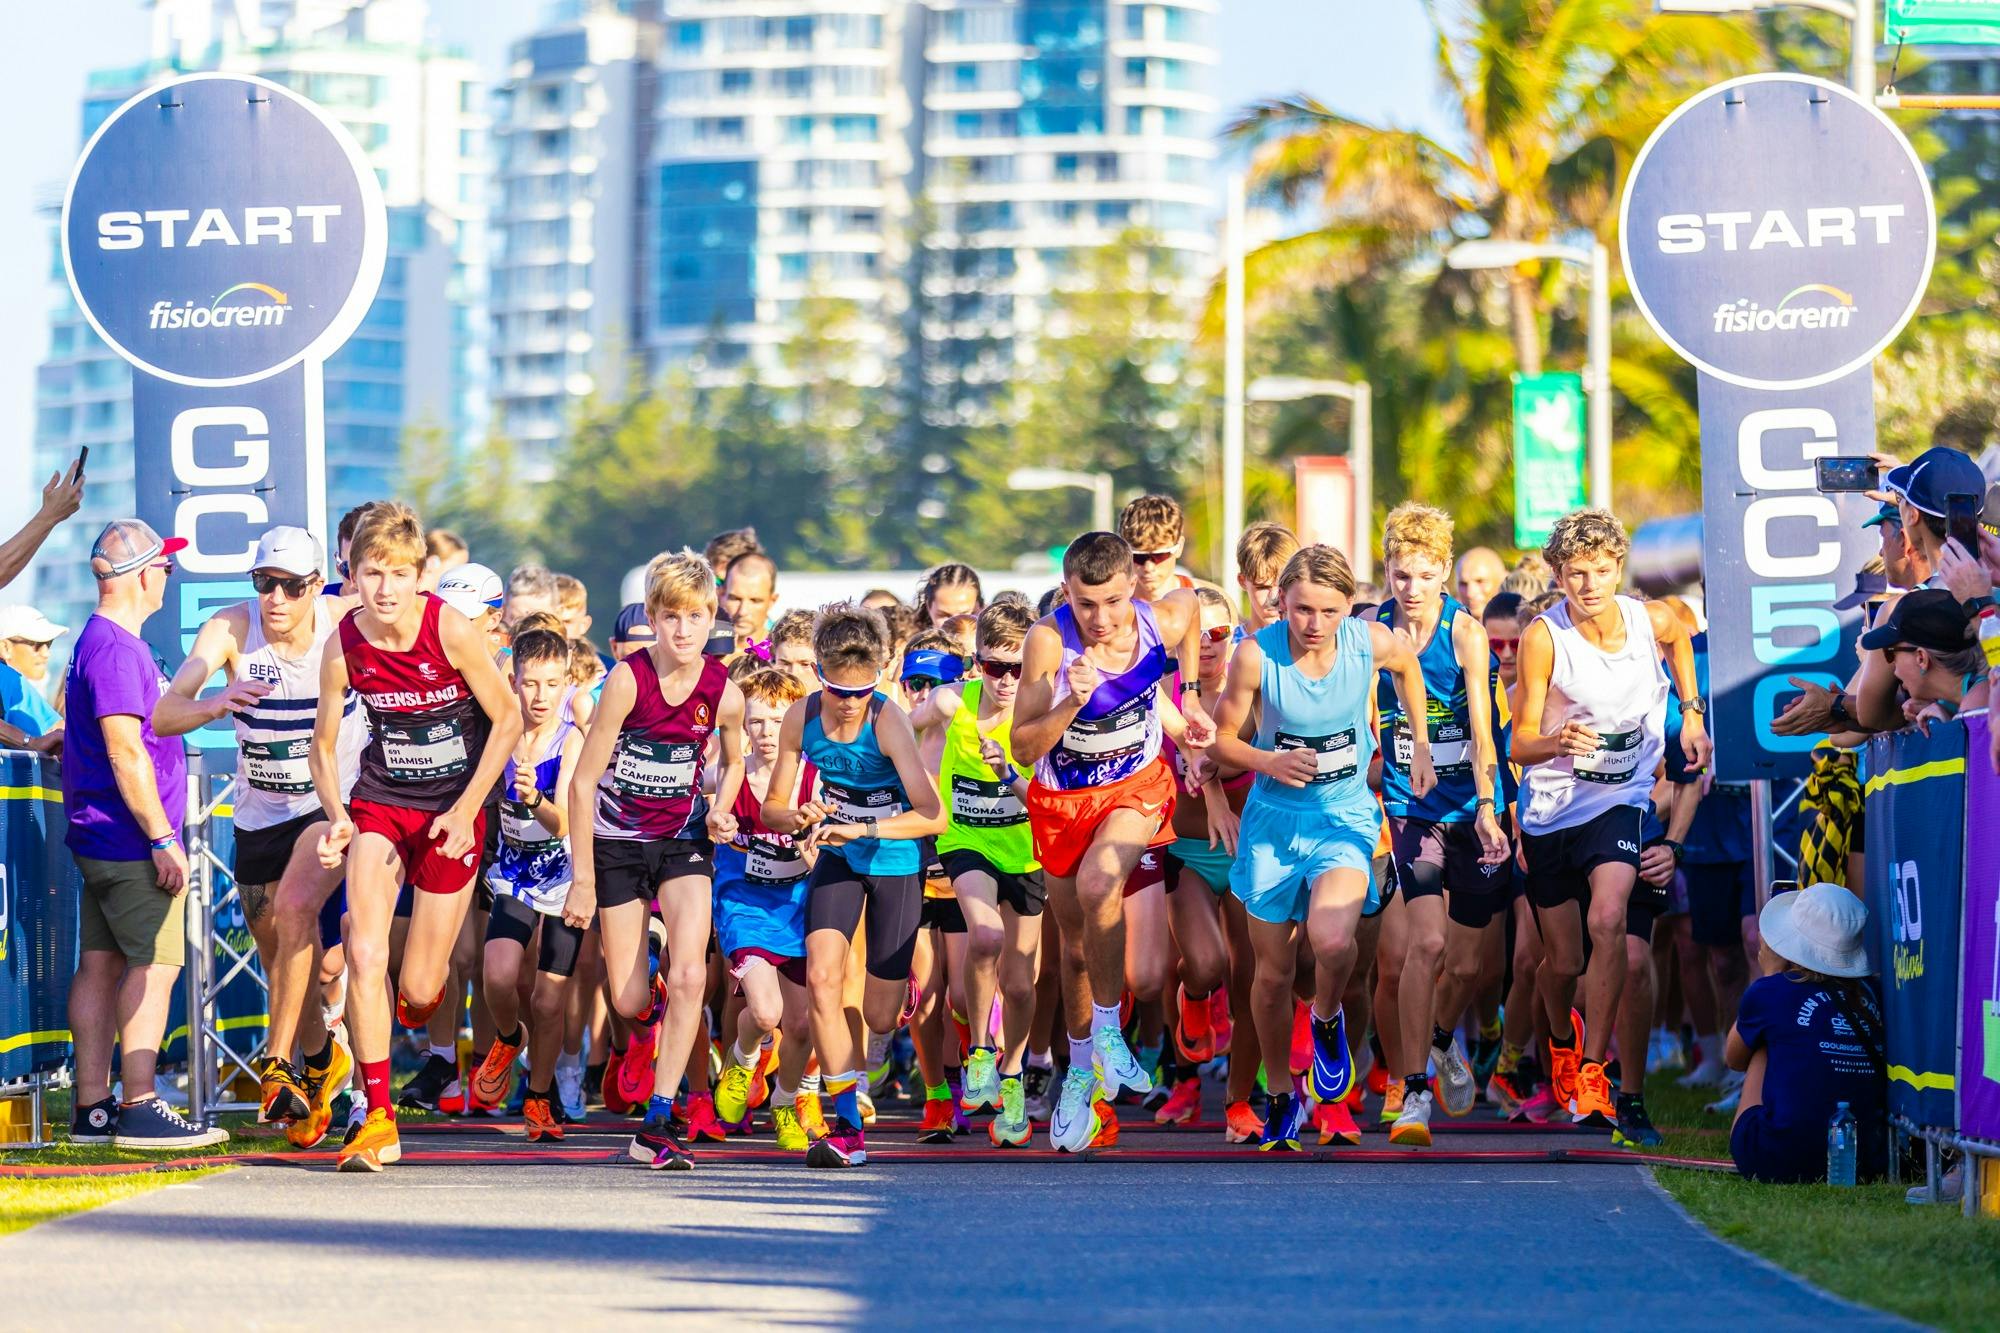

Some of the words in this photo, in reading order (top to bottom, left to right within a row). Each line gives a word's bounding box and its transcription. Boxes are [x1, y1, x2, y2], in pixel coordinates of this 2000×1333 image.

[97, 204, 342, 250] START
[1657, 204, 1905, 254] START
[149, 300, 285, 329] fisiocrem
[1713, 300, 1851, 333] fisiocrem
[1738, 408, 1845, 753] GC50
[389, 757, 433, 765] HAMISH
[622, 759, 637, 769] 692
[1603, 752, 1636, 765] HUNTER
[250, 770, 292, 780] DAVIDE
[620, 768, 677, 783] CAMERON
[957, 804, 1005, 815] THOMAS
[503, 825, 521, 837] LUKE
[1617, 839, 1638, 853] QAS
[751, 866, 772, 876] LEO
[1796, 997, 1819, 1027] RUN
